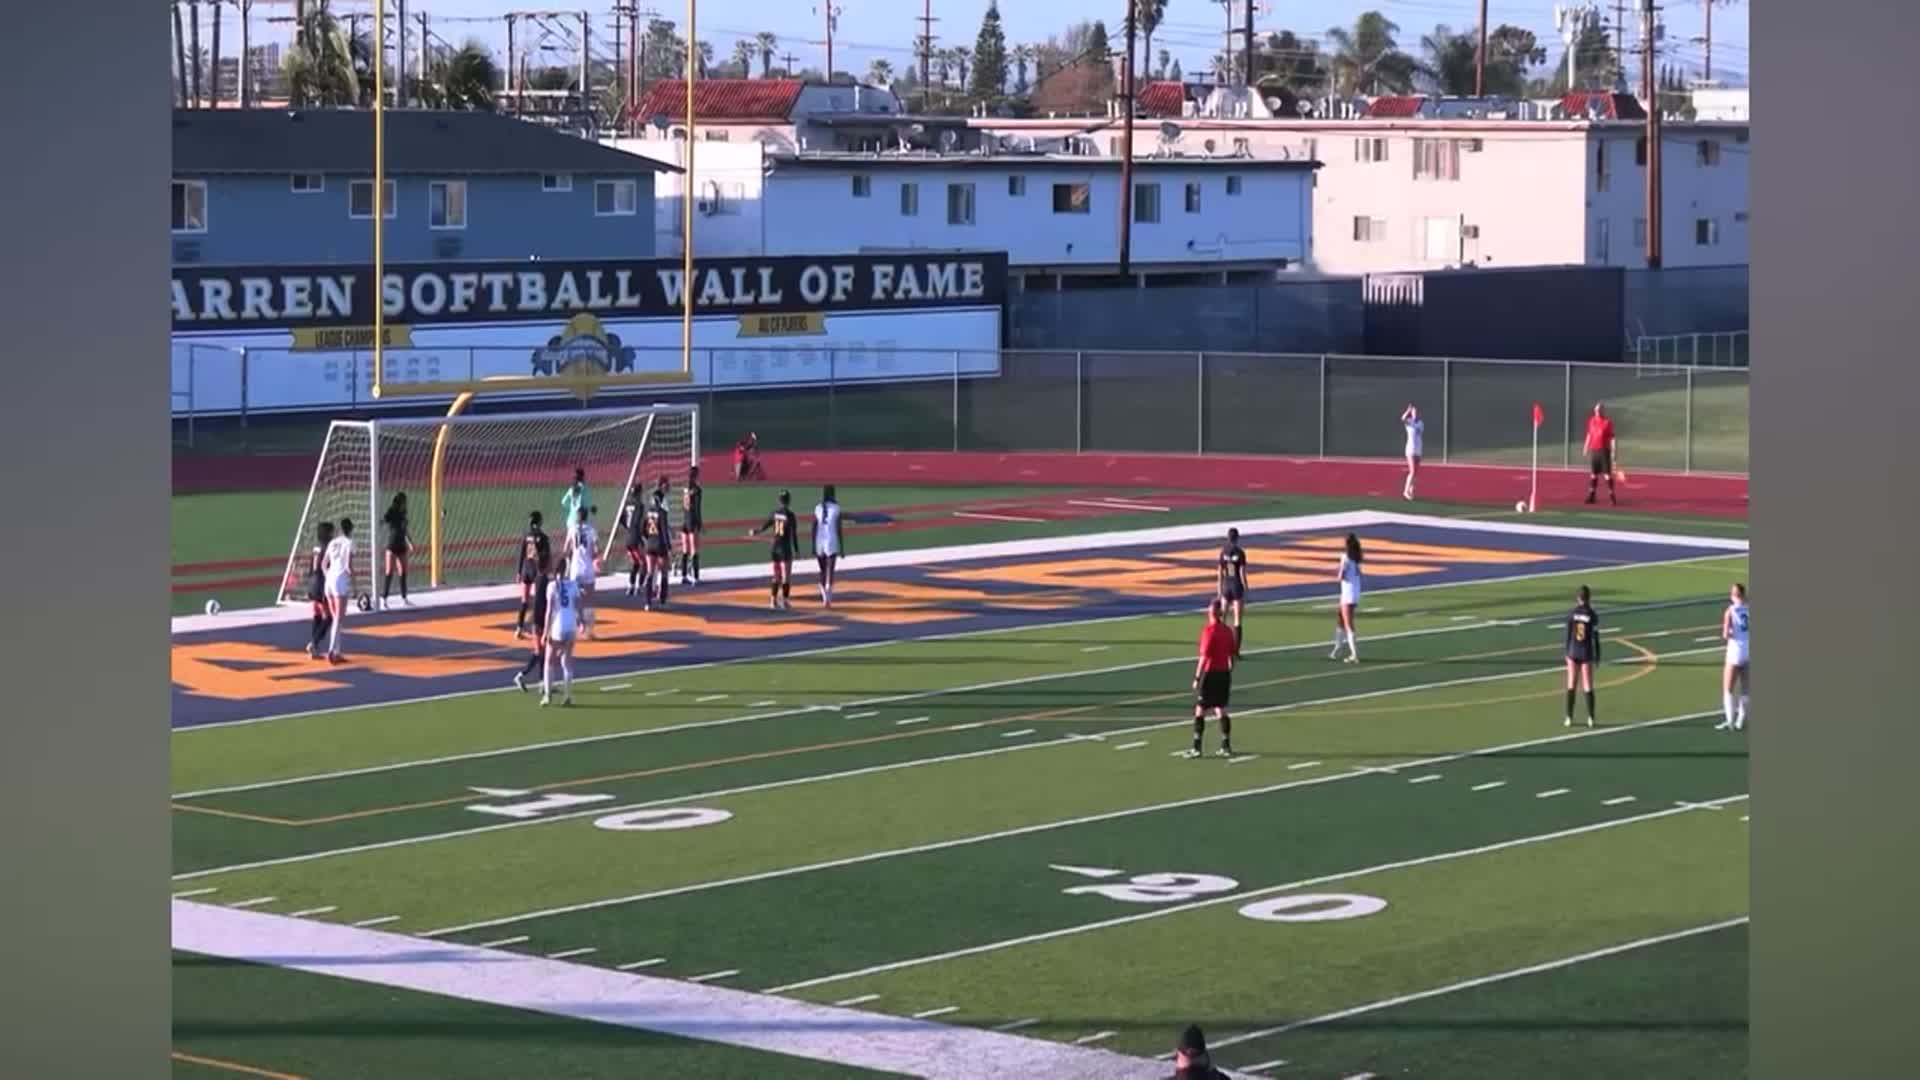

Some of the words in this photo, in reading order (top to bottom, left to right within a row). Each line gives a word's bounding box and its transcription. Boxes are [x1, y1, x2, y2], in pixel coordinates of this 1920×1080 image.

[171, 276, 356, 320] ARREN
[381, 270, 640, 316] SOFTBALL
[657, 267, 782, 307] WALL
[800, 265, 856, 300] OF
[872, 263, 985, 299] FAME
